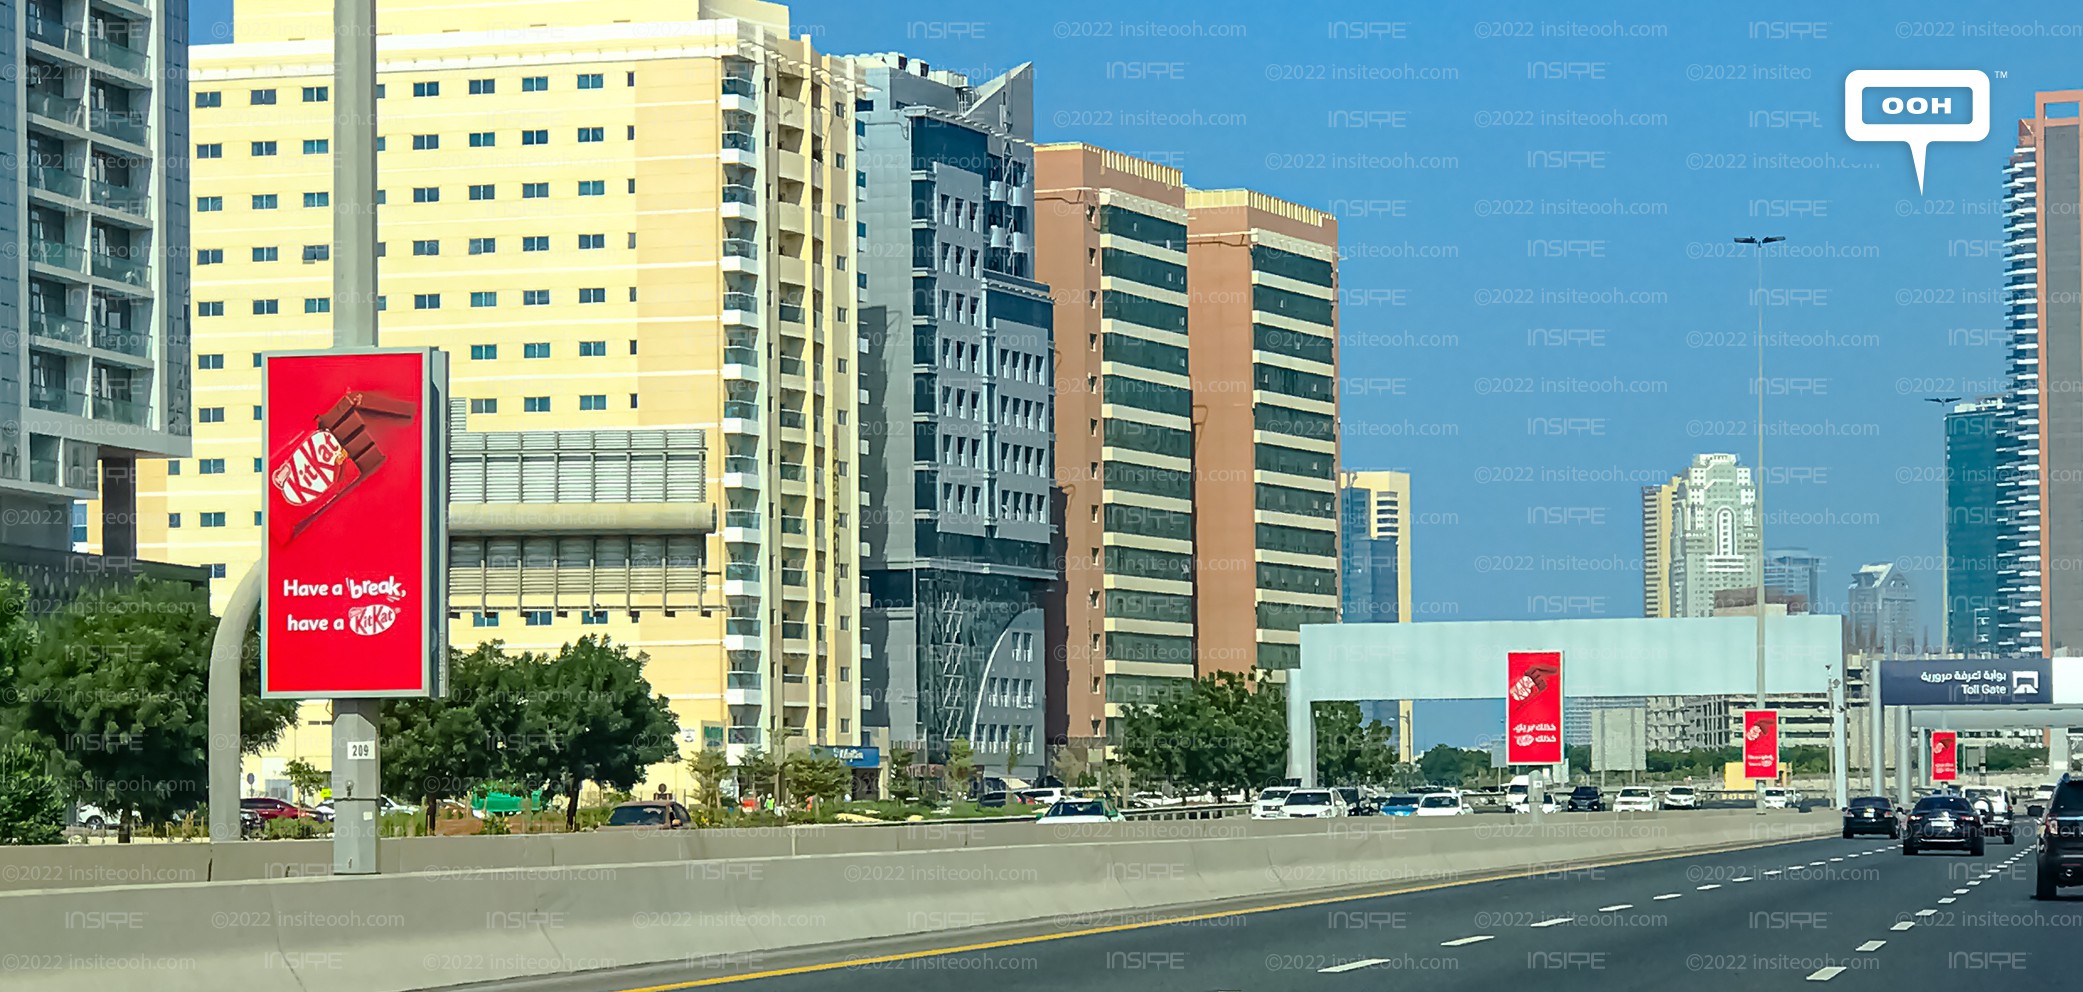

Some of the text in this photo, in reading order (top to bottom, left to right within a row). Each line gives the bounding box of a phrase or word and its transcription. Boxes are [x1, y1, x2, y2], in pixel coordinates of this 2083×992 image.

[281, 431, 341, 504] KitKat
[284, 579, 329, 596] Have
[332, 584, 343, 596] a
[287, 605, 395, 635] have a KitKat
[1920, 669, 2007, 683] بوابة تعرفة مرورية
[1961, 684, 2007, 694] Toll Gate
[352, 744, 369, 757] 209
